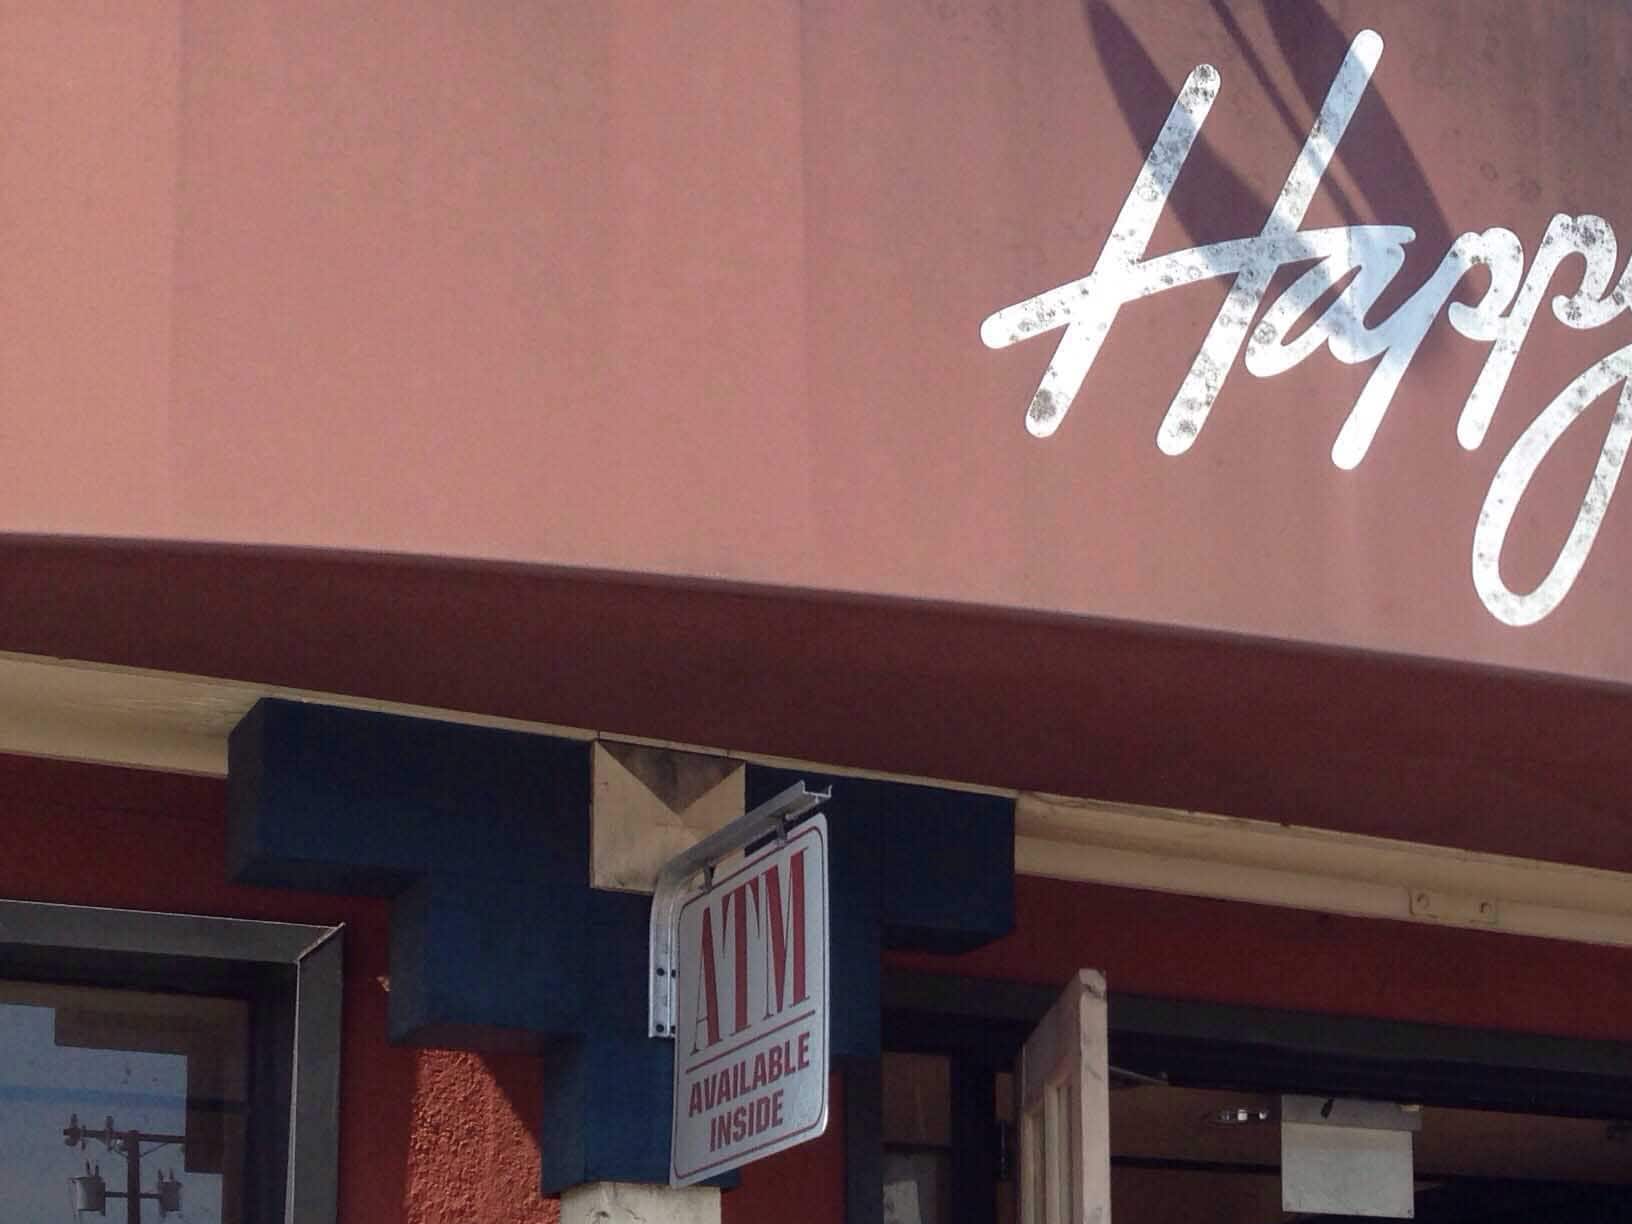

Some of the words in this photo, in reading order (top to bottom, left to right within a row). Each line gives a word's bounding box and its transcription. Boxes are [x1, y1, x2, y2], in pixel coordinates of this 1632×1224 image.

[689, 845, 811, 1056] ATM
[688, 1031, 811, 1118] AVAILABLE
[709, 1088, 785, 1153] INSIDE
